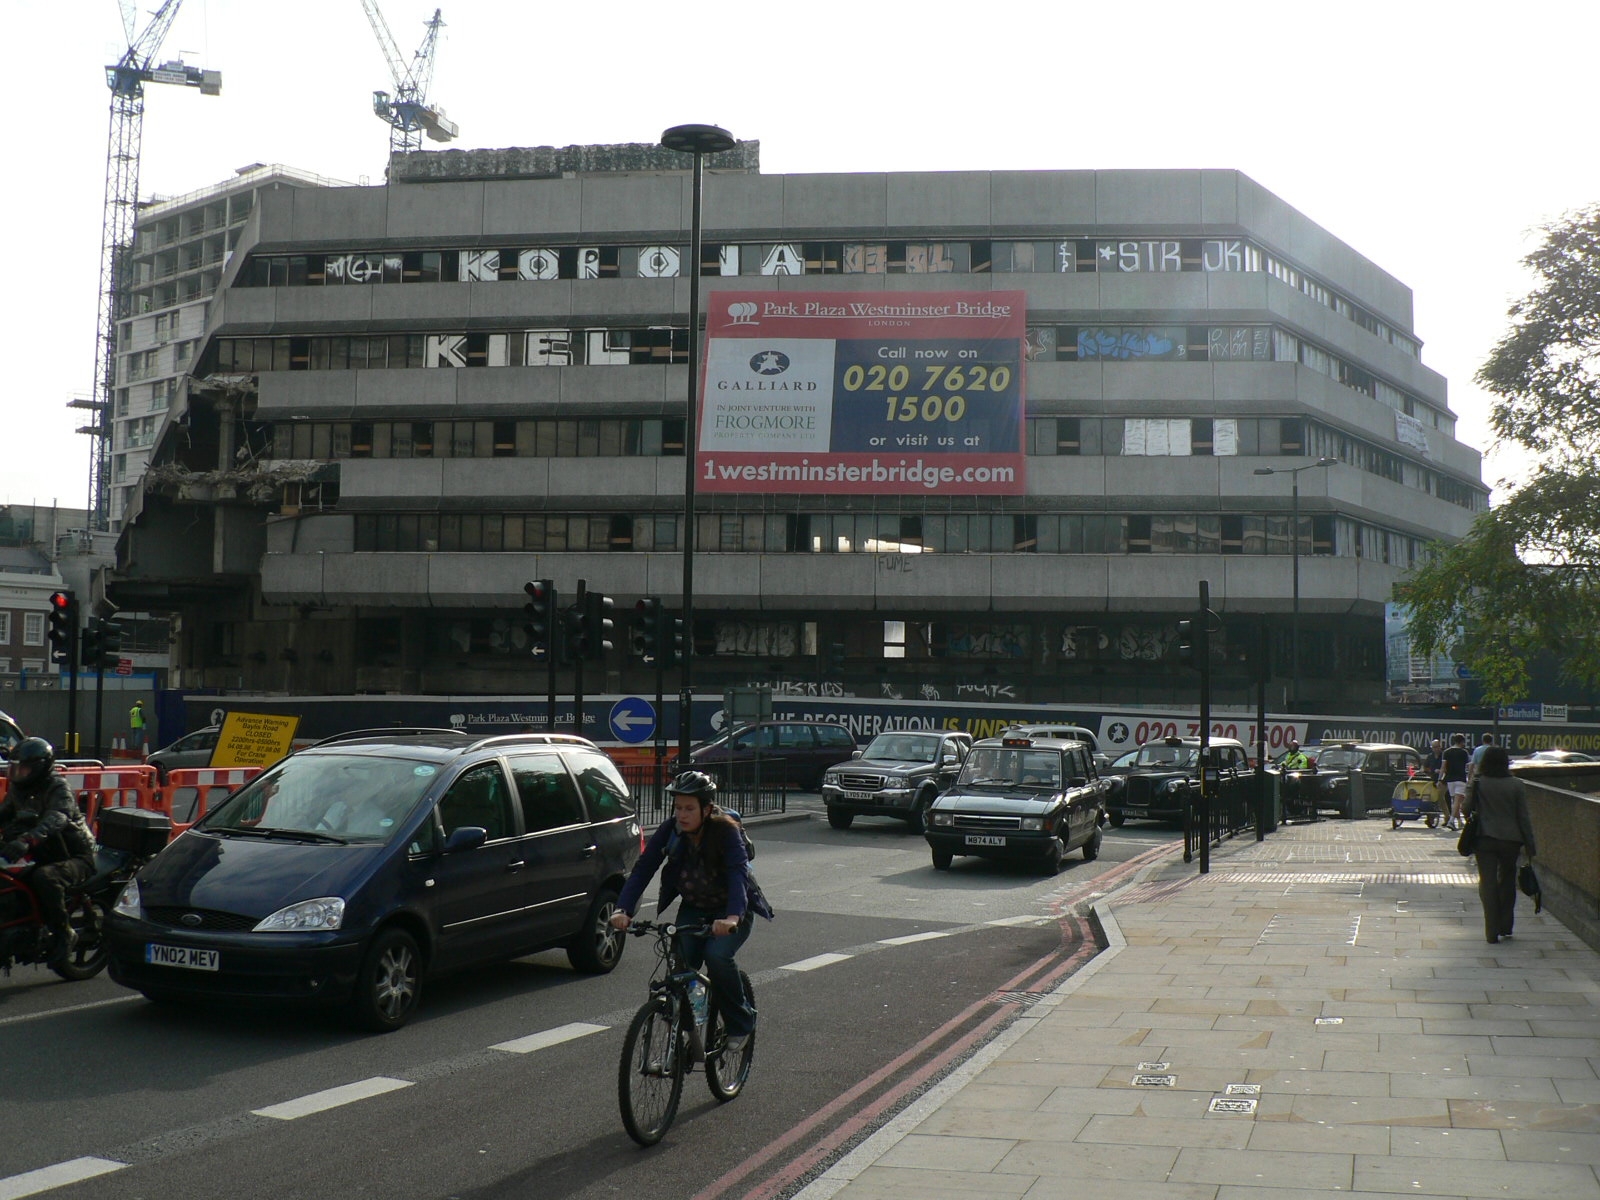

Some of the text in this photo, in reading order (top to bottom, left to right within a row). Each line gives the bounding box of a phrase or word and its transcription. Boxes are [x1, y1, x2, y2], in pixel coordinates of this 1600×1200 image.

[764, 302, 1011, 319] Park Plaza Westminster Bridge
[423, 327, 631, 369] KIEL
[878, 346, 978, 359] Call now on
[717, 380, 817, 391] GALLIARD
[843, 365, 1011, 392] 020 7620
[886, 396, 966, 422] 1500
[715, 415, 816, 430] FROGMORE
[869, 434, 980, 446] or visit us at
[703, 459, 1015, 488] 1westminsterbridge.com
[878, 557, 913, 573] FUME
[468, 713, 485, 722] Park
[488, 713, 510, 722] Plaza
[511, 713, 563, 722] Westminer
[1508, 707, 1540, 718] Barhale
[1362, 730, 1397, 744] YOUR
[1402, 731, 1434, 748] OWN
[1440, 732, 1475, 748] HOEL
[1517, 734, 1600, 750] OVERLOOKING
[152, 946, 217, 968] YN02 MEV
